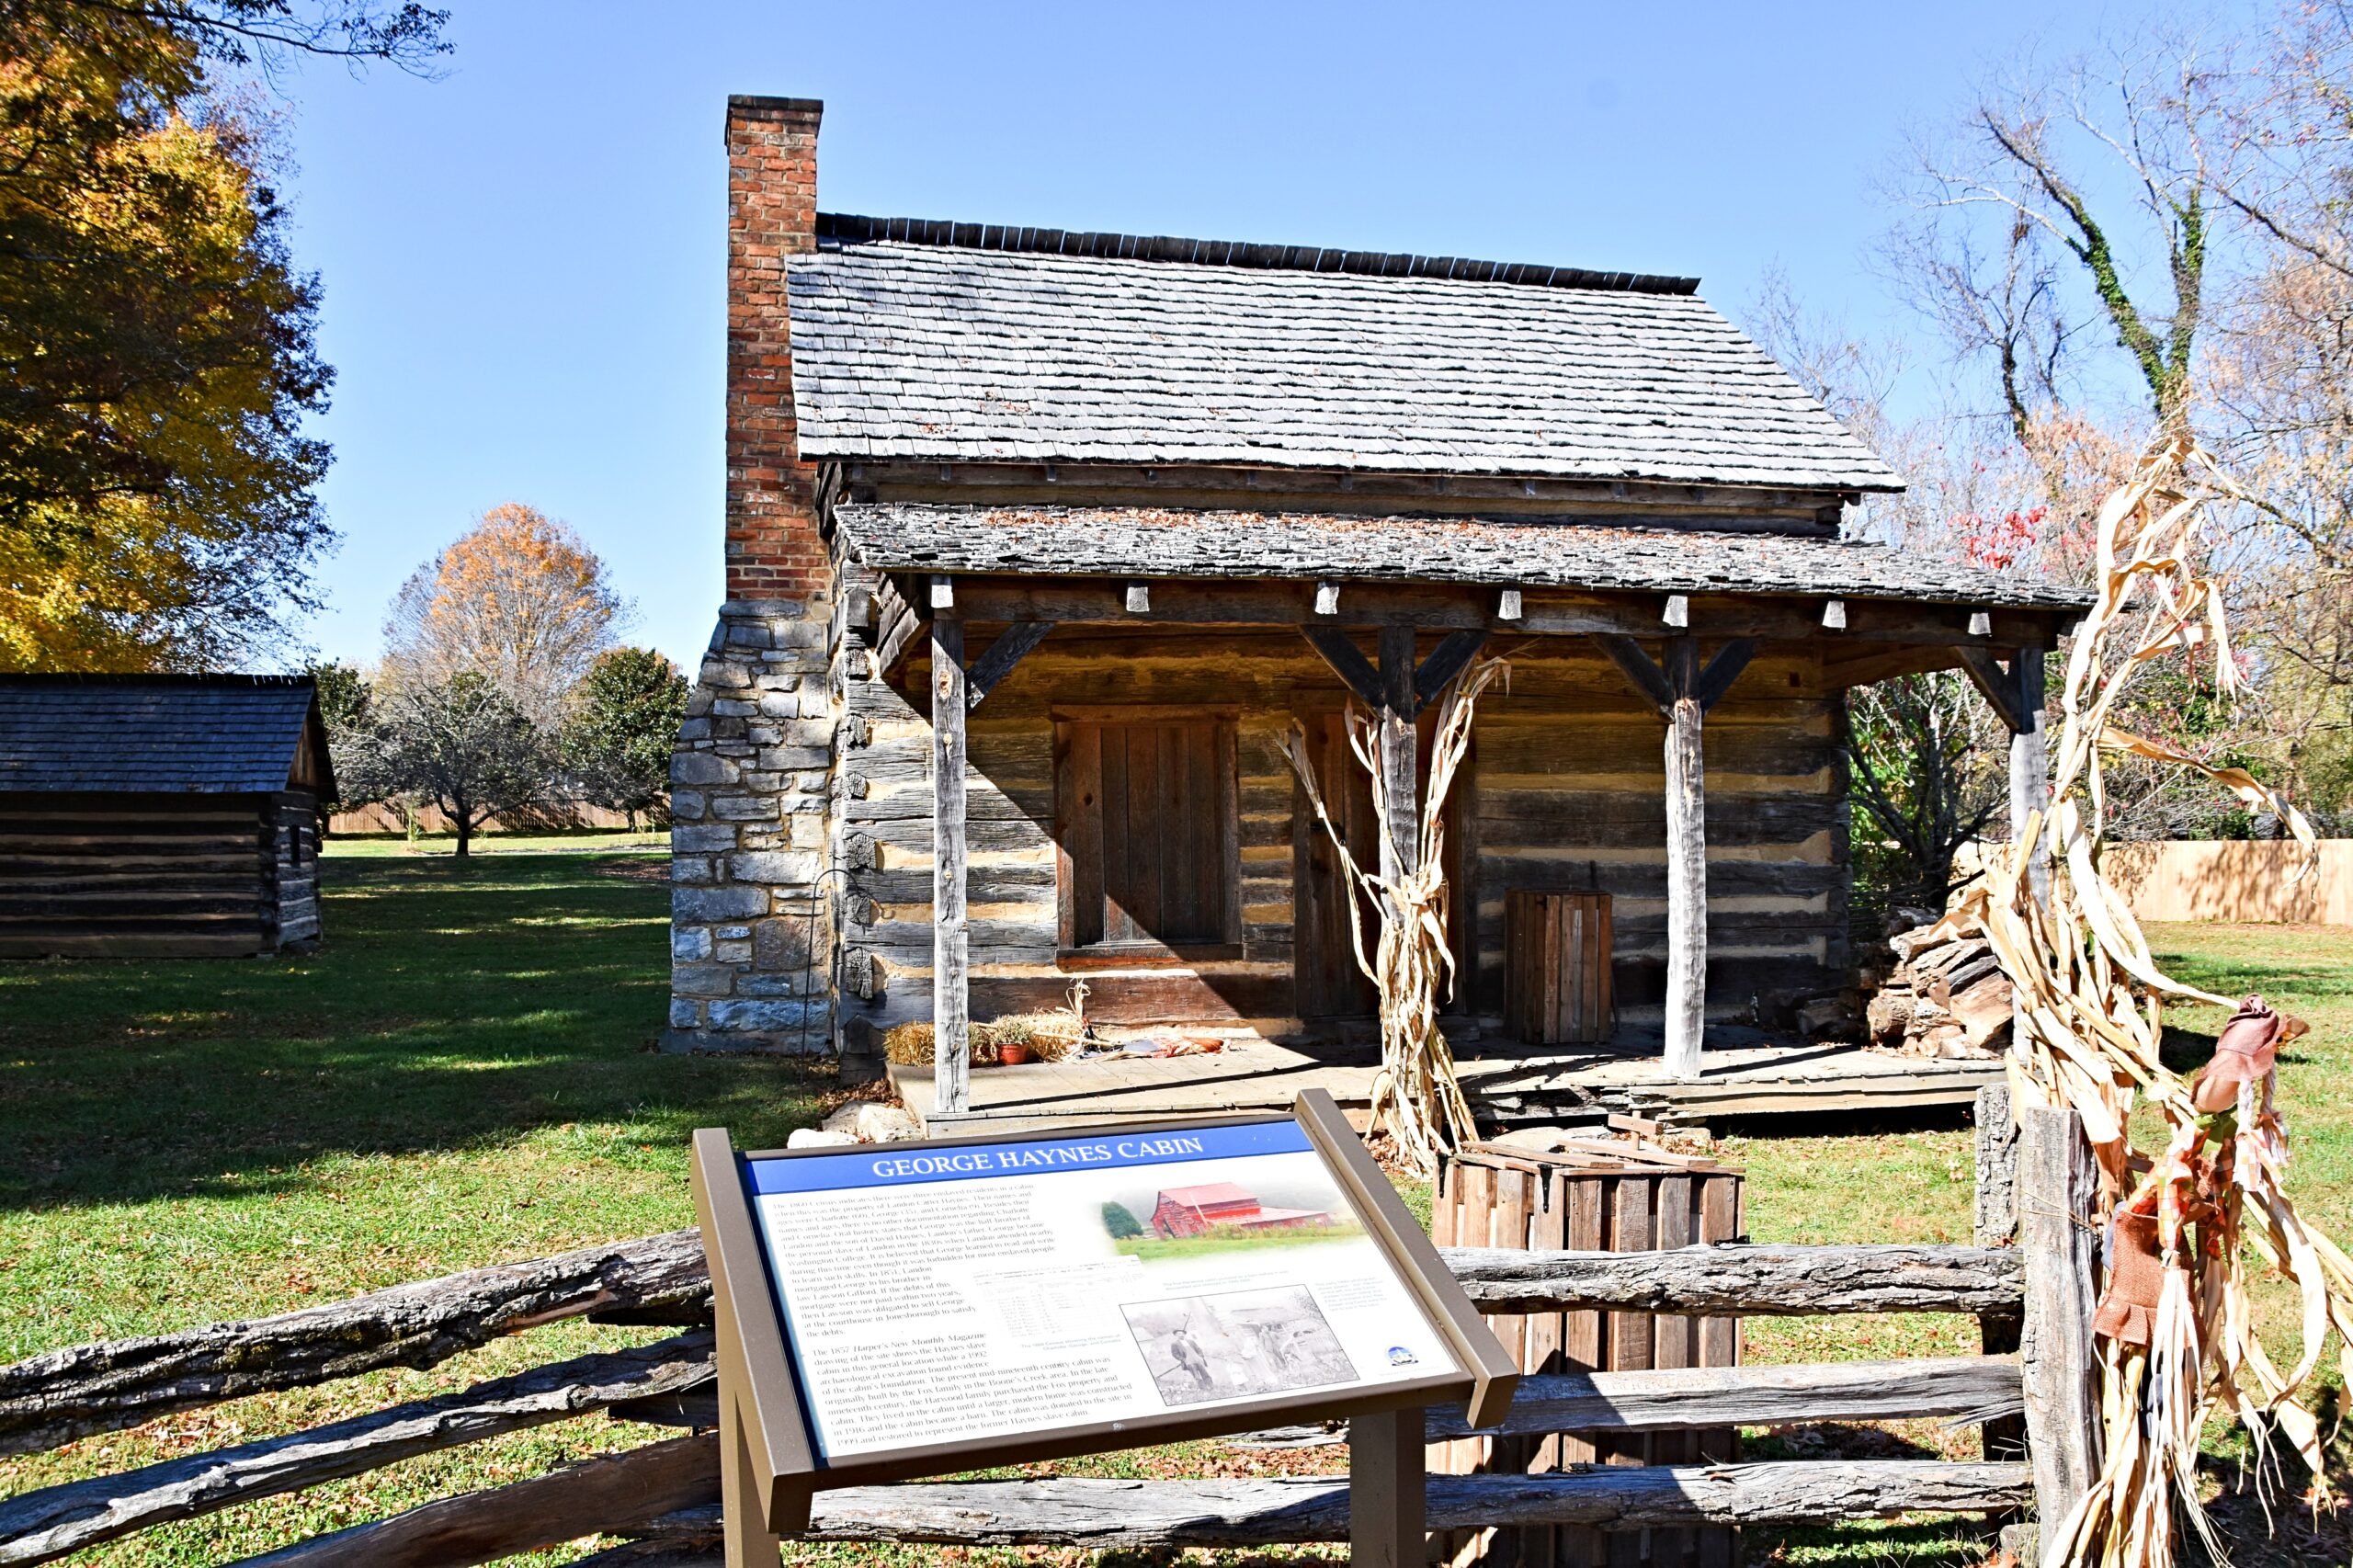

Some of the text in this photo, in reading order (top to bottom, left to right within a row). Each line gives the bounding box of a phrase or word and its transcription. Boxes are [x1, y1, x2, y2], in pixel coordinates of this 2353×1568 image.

[872, 1137, 1204, 1177] GEORGE HAYNES CABIN
[813, 1358, 849, 1366] drawing
[892, 1350, 918, 1358] shows
[934, 1345, 965, 1353] Haynes
[853, 1342, 889, 1353] Harper's
[911, 1335, 945, 1346] Monthly
[948, 1333, 986, 1342] Magazine
[816, 1368, 840, 1376] cabin
[870, 1360, 900, 1371] general
[901, 1358, 935, 1367] location
[936, 1354, 959, 1362] while
[820, 1362, 989, 1386] archaeological excavation found evidence
[848, 1382, 879, 1392] cabin's
[930, 1375, 946, 1383] The
[947, 1372, 977, 1382] present
[1072, 1358, 1094, 1367] cabin
[824, 1394, 865, 1405] originally
[867, 1392, 888, 1401] built
[902, 1389, 915, 1397] the
[935, 1383, 961, 1392] family
[988, 1376, 1022, 1387] Boone's
[1022, 1373, 1048, 1382] Creek
[827, 1403, 872, 1415] nineteenth
[909, 1398, 923, 1406] the
[924, 1392, 964, 1404] Harwood
[964, 1390, 991, 1400] family
[993, 1384, 1036, 1398] purchased
[1067, 1378, 1101, 1389] property
[1103, 1374, 1119, 1382] and
[859, 1415, 880, 1423] They
[882, 1410, 904, 1420] lived
[931, 1405, 955, 1414] cabin
[956, 1402, 976, 1411] until
[1012, 1394, 1044, 1404] modern
[1083, 1382, 1132, 1394] constructed
[860, 1435, 877, 1444] and
[878, 1430, 913, 1442] restored
[925, 1425, 963, 1437] represent
[980, 1420, 1008, 1429] former
[1010, 1416, 1042, 1425] Haynes
[867, 1423, 883, 1433] and
[884, 1422, 898, 1430] the
[900, 1420, 924, 1428] cabin
[925, 1416, 958, 1426] became
[991, 1409, 1006, 1417] The
[1008, 1406, 1031, 1415] cabin
[1050, 1399, 1083, 1410] donated
